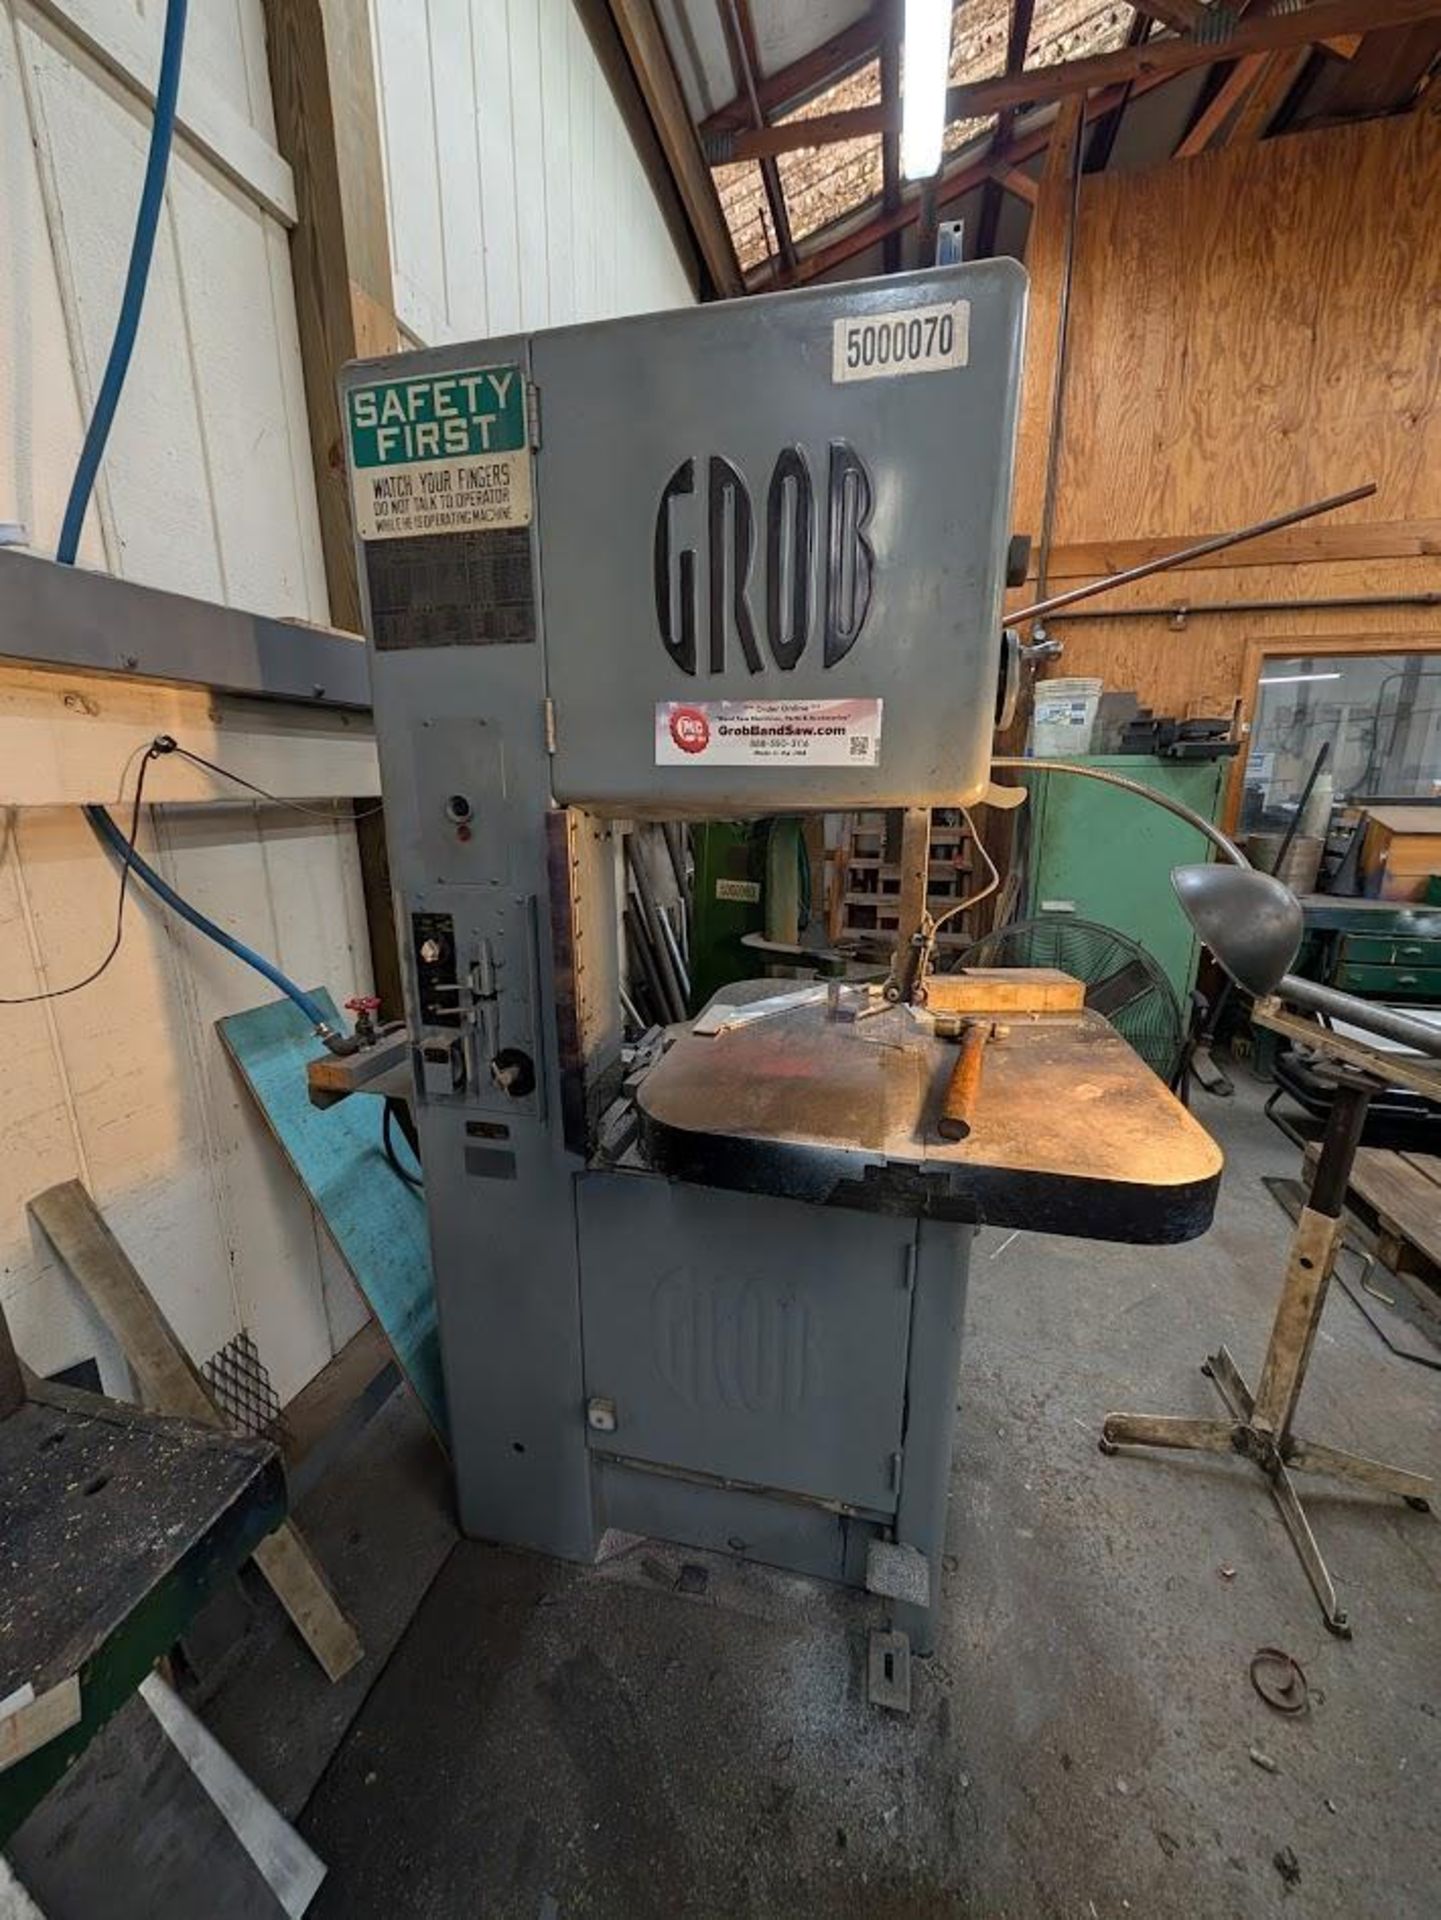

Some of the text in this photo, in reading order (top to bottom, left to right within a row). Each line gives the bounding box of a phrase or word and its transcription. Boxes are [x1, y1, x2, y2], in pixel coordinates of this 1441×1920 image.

[847, 313, 954, 368] 5000070
[354, 372, 513, 428] SAFETY
[376, 414, 497, 461] FIRST
[373, 463, 511, 499] WATCH YOUR FINGERS
[373, 488, 511, 516] DO NOT TALK TO OPERATOR
[424, 509, 472, 527] OPERATING
[472, 505, 512, 523] MACHINE
[654, 437, 876, 677] GROB
[718, 725, 846, 736] GrobBandSaw.com
